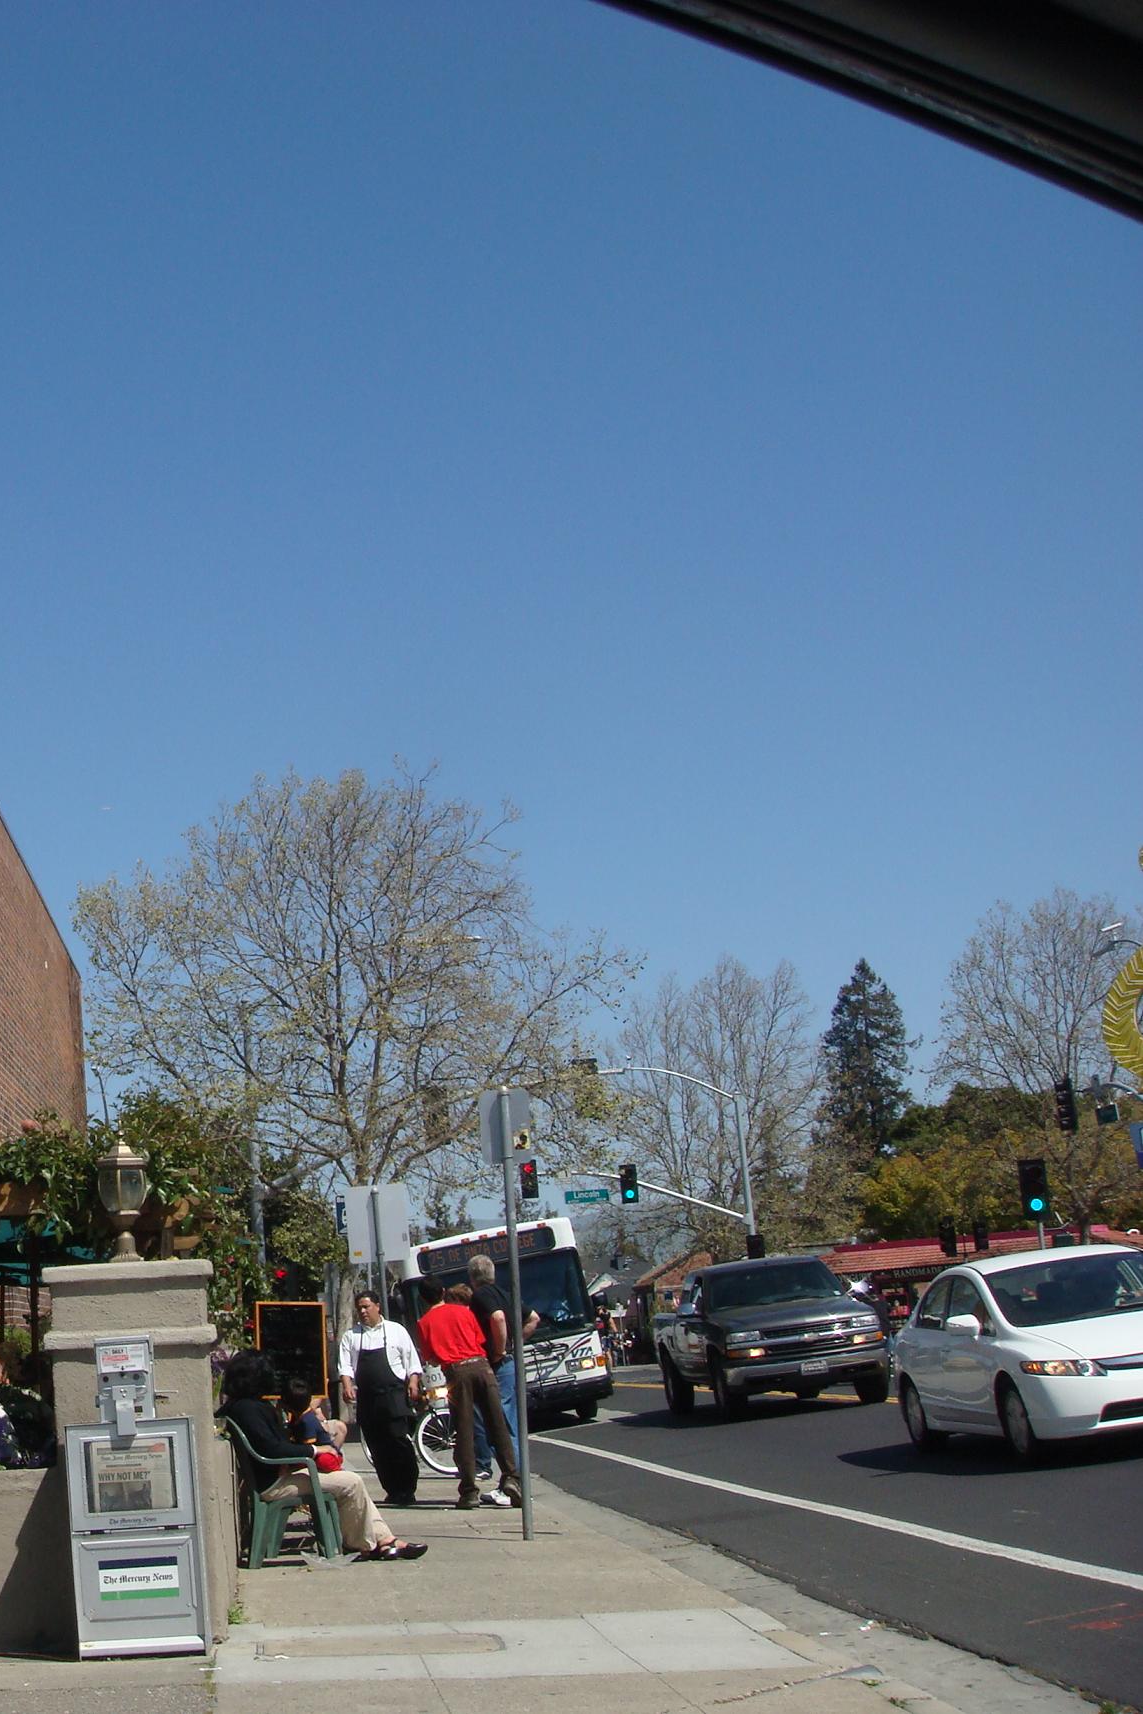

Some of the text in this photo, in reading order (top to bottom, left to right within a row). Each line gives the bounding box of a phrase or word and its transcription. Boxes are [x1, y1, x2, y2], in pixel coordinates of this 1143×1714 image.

[573, 1190, 601, 1199] Lincoln
[571, 1346, 594, 1359] VTA
[97, 1472, 116, 1481] WHY
[116, 1471, 132, 1481] NOT
[103, 1572, 174, 1584] The Mercury News
